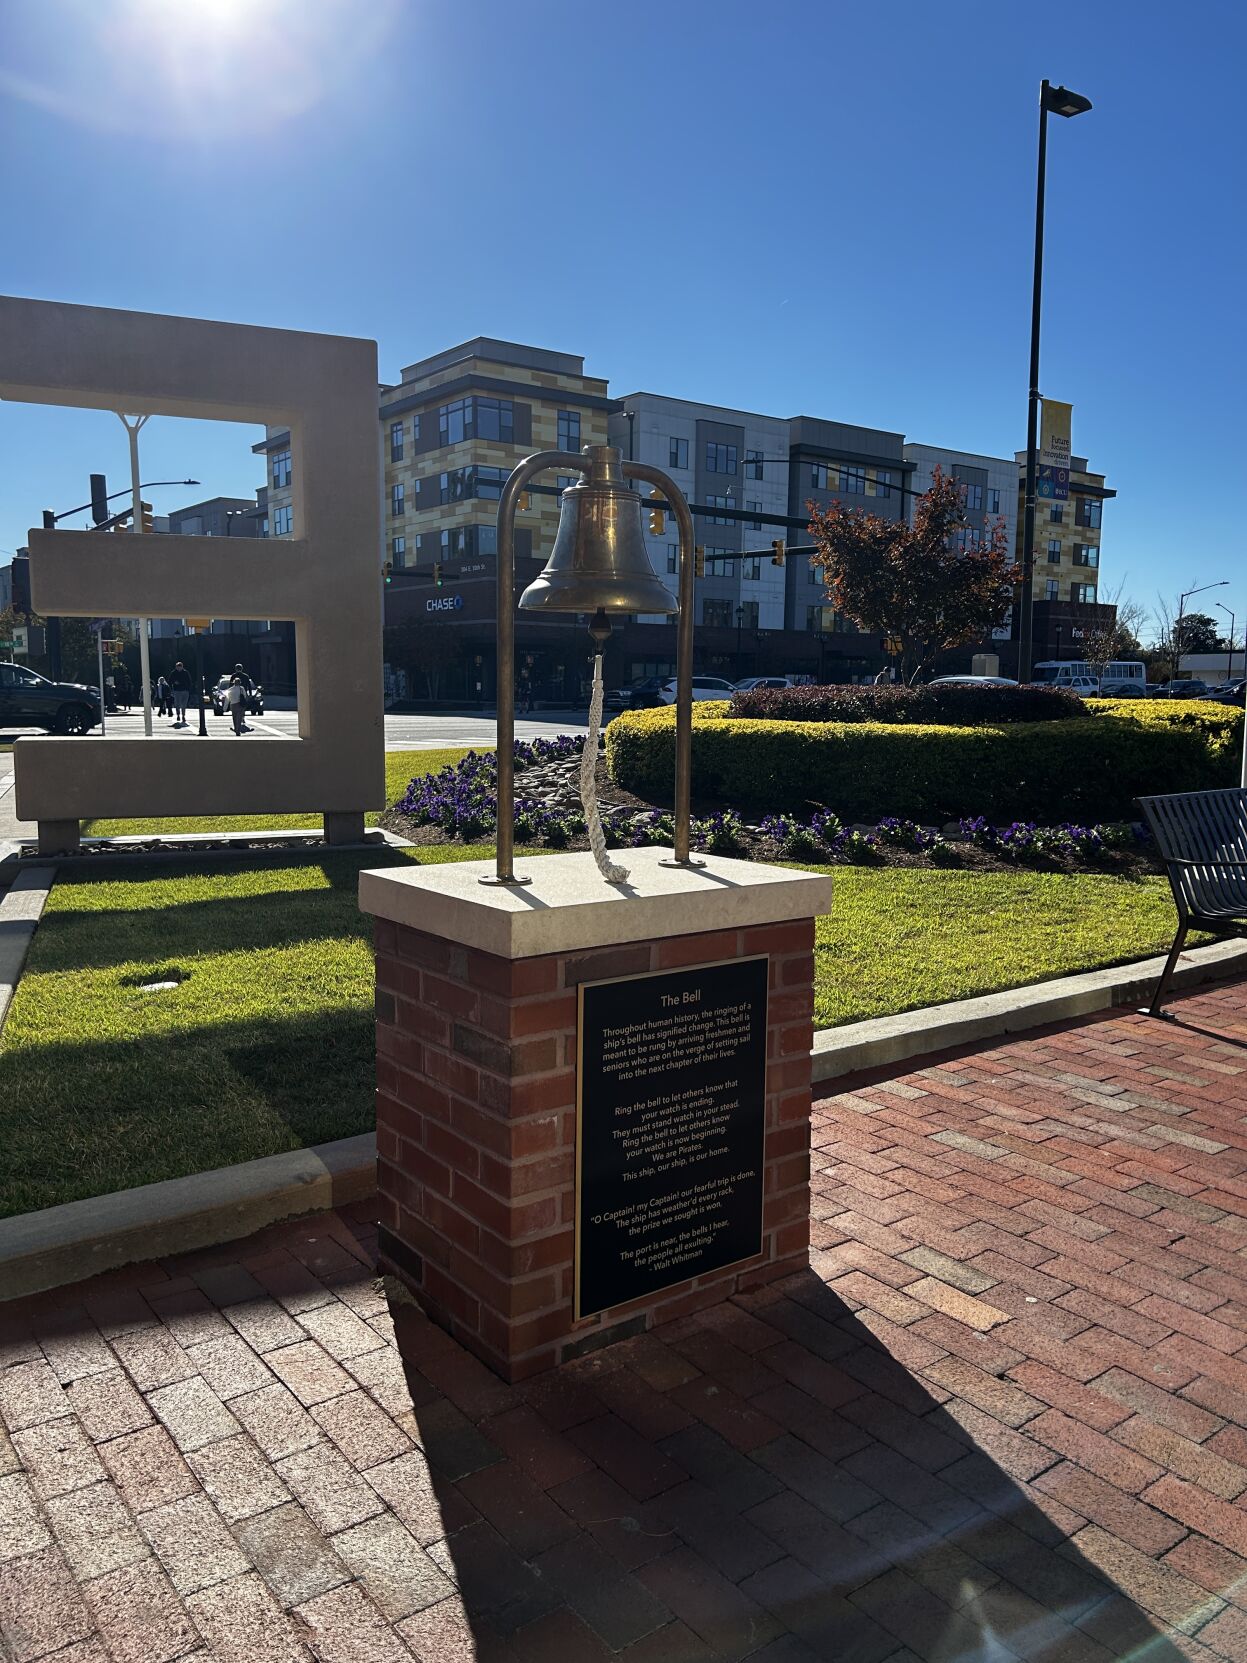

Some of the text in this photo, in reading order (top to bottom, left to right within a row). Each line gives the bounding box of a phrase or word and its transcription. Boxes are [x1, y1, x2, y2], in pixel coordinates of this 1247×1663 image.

[1051, 435, 1070, 446] Future
[427, 598, 453, 611] CHASE
[660, 989, 701, 1007] The Bell
[603, 1022, 647, 1038] Throughout
[648, 1018, 673, 1029] human
[674, 1013, 700, 1024] history,
[701, 1010, 713, 1019] the
[714, 1005, 738, 1016] ringing
[739, 1002, 747, 1011] of
[627, 1033, 641, 1045] bell
[642, 1032, 656, 1041] has
[656, 1024, 687, 1040] signified
[688, 1021, 716, 1032] change.
[715, 1017, 730, 1026] This
[730, 1013, 743, 1024] bell
[744, 1012, 750, 1021] is
[602, 1022, 751, 1061] meant to be rung by arriving freshmen and
[602, 1033, 751, 1073] seniors who are on the verge of setting sail
[618, 1071, 634, 1081] into
[634, 1068, 647, 1077] the
[648, 1064, 665, 1074] next
[666, 1058, 693, 1070] chapter
[693, 1054, 702, 1064] of
[702, 1051, 718, 1062] their
[615, 1106, 632, 1116] Ring
[633, 1101, 646, 1111] the
[647, 1096, 661, 1108] bell
[671, 1093, 681, 1102] let
[682, 1088, 704, 1099] others
[705, 1084, 724, 1094] know
[725, 1079, 738, 1089] that
[641, 1097, 715, 1123] your watch is ending.
[611, 1129, 631, 1139] They
[632, 1123, 651, 1134] must
[651, 1116, 672, 1130] stand
[673, 1111, 694, 1123] watch
[695, 1109, 702, 1118] in
[703, 1106, 719, 1118] your
[622, 1114, 731, 1148] Ring the bell to let others know
[622, 1146, 730, 1182] This ship, our ship, is our home.
[626, 1148, 643, 1161] your
[644, 1140, 666, 1153] watch
[667, 1139, 674, 1147] is
[674, 1136, 690, 1145] now
[652, 1143, 704, 1162] We are Pirates.
[603, 1204, 635, 1221] Captain!
[636, 1202, 648, 1211] my
[649, 1191, 680, 1207] Captain!
[681, 1189, 693, 1197] our
[694, 1179, 716, 1193] fearful
[717, 1177, 730, 1186] trip
[730, 1174, 736, 1182] is
[615, 1219, 630, 1229] The
[631, 1213, 647, 1224] ship
[648, 1209, 661, 1219] has
[698, 1192, 718, 1203] every
[629, 1226, 641, 1236] the
[642, 1221, 661, 1234] prize
[662, 1217, 673, 1225] we
[674, 1207, 698, 1221] sought
[699, 1205, 705, 1213] is
[620, 1251, 634, 1261] The
[635, 1244, 652, 1258] port
[653, 1242, 659, 1250] is
[660, 1237, 678, 1247] near,
[679, 1232, 691, 1241] the
[692, 1225, 708, 1237] bells
[634, 1257, 646, 1267] the
[648, 1248, 673, 1264] people
[674, 1243, 683, 1253] all
[653, 1259, 671, 1271] Walt
[671, 1249, 703, 1265] Whitman
